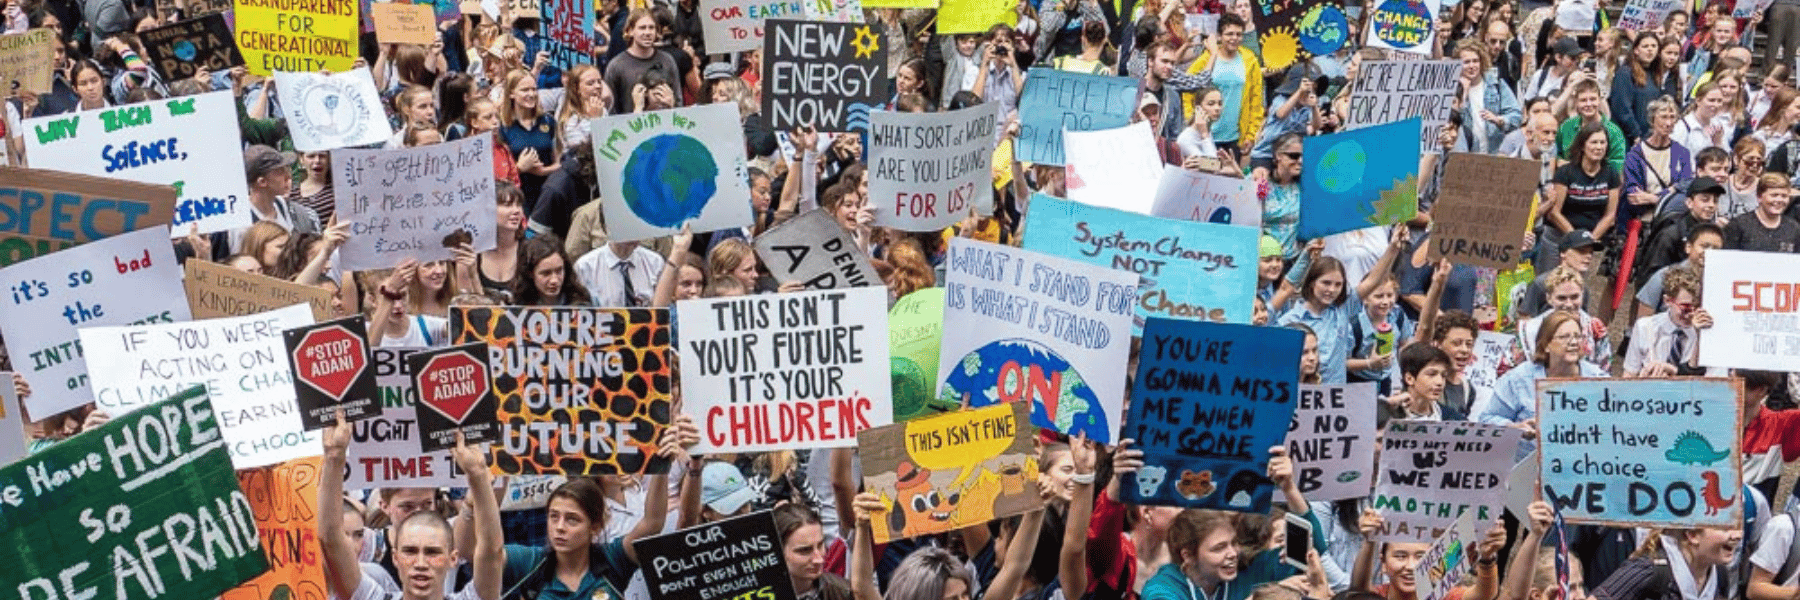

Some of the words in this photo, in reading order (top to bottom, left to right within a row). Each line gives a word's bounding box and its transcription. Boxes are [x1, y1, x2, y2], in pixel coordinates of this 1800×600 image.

[277, 13, 315, 34] FOR
[711, 6, 743, 21] OUR
[749, 1, 800, 19] EARTH
[1374, 9, 1431, 31] CHANGE
[240, 31, 352, 58] GENERATIONAL
[730, 27, 748, 40] TO
[774, 23, 846, 59] NEW
[262, 54, 327, 72] EQUITY
[1396, 61, 1461, 93] LEARNING
[771, 61, 880, 98] ENERGY
[35, 115, 80, 145] WHY
[99, 105, 152, 133] TEACH
[771, 98, 844, 129] NOW
[1347, 94, 1379, 125] FOR
[871, 122, 912, 149] WHAT
[915, 124, 953, 150] SORT
[965, 113, 995, 143] WORLD
[875, 157, 906, 183] ARE
[911, 154, 941, 184] YOU
[945, 148, 986, 180] LEAVING
[173, 195, 237, 227] CIENCE?
[895, 192, 937, 219] FOR
[947, 181, 975, 214] US?
[1072, 221, 1151, 257] System
[1155, 235, 1239, 272] Change
[1439, 237, 1515, 263] URANUS
[11, 279, 50, 305] it's
[68, 269, 93, 288] so
[114, 248, 153, 275] bad
[951, 245, 1011, 283] WHAT
[1015, 257, 1025, 287] I
[1029, 262, 1091, 308] STAND
[1095, 281, 1139, 317] FOR
[1111, 253, 1167, 277] NOT
[217, 273, 262, 297] LEARNT
[270, 285, 301, 305] THIS
[311, 296, 328, 312] IN
[62, 301, 104, 326] the
[506, 309, 615, 347] YOU'RE
[711, 299, 770, 332] THIS
[778, 293, 846, 329] ISN'T
[948, 281, 967, 310] IS
[971, 285, 1029, 325] WHAT
[1027, 300, 1040, 330] I
[1038, 304, 1111, 350] STAND
[121, 330, 149, 353] IF
[166, 328, 209, 351] YOU
[222, 317, 284, 344] WERE
[305, 338, 352, 361] #STOP
[689, 333, 759, 377] YOUR
[771, 324, 865, 369] FUTURE
[1154, 333, 1233, 365] YOU'RE
[139, 353, 228, 380] ACTING
[239, 346, 275, 370] ON
[310, 354, 355, 379] ADANI
[429, 364, 476, 383] #STOP
[488, 346, 624, 381] BURNING
[67, 373, 88, 390] ar
[98, 379, 224, 407] CLIME
[433, 378, 477, 402] ADANI
[524, 381, 591, 410] OUR
[728, 371, 776, 403] IT'S
[779, 366, 844, 401] YOUR
[996, 358, 1063, 421] ON
[1144, 367, 1222, 397] GONNA
[1230, 375, 1291, 404] MISS
[1141, 397, 1185, 425] ME
[1192, 401, 1256, 431] WHEN
[1300, 387, 1346, 410] ERE
[1545, 390, 1588, 413] The
[1597, 387, 1704, 416] dinosaurs
[706, 389, 872, 448] CHILDREN'S
[908, 429, 942, 453] THIS
[946, 419, 981, 446] ISN'T
[982, 414, 1015, 440] FINE
[1313, 414, 1349, 434] NO
[103, 395, 220, 480] HOPE
[482, 423, 639, 456] UTURE
[1134, 424, 1171, 448] I'M
[1177, 427, 1255, 456] GONE
[1290, 434, 1360, 463] ANET
[1385, 438, 1418, 451] DOES
[1453, 441, 1494, 454] NEED
[1547, 423, 1604, 446] didn't
[1612, 423, 1660, 448] have
[358, 455, 435, 483] TIME
[1412, 450, 1448, 470] US
[1551, 457, 1563, 474] a
[1572, 452, 1650, 481] choice,
[26, 460, 103, 498] Have
[1298, 466, 1324, 493] B
[1388, 469, 1431, 489] WE
[1439, 470, 1500, 490] NEED
[0, 485, 24, 508] e
[1375, 493, 1490, 521] MOTHER
[1544, 482, 1607, 515] WE
[1627, 480, 1697, 518] DO
[79, 502, 133, 544] so
[684, 525, 727, 547] OUR
[113, 490, 261, 600] AFRAID
[652, 534, 773, 579] POLITICIANS
[702, 564, 738, 585] EVEN
[740, 552, 779, 574] HAVE
[699, 574, 759, 600] ENOUGH
